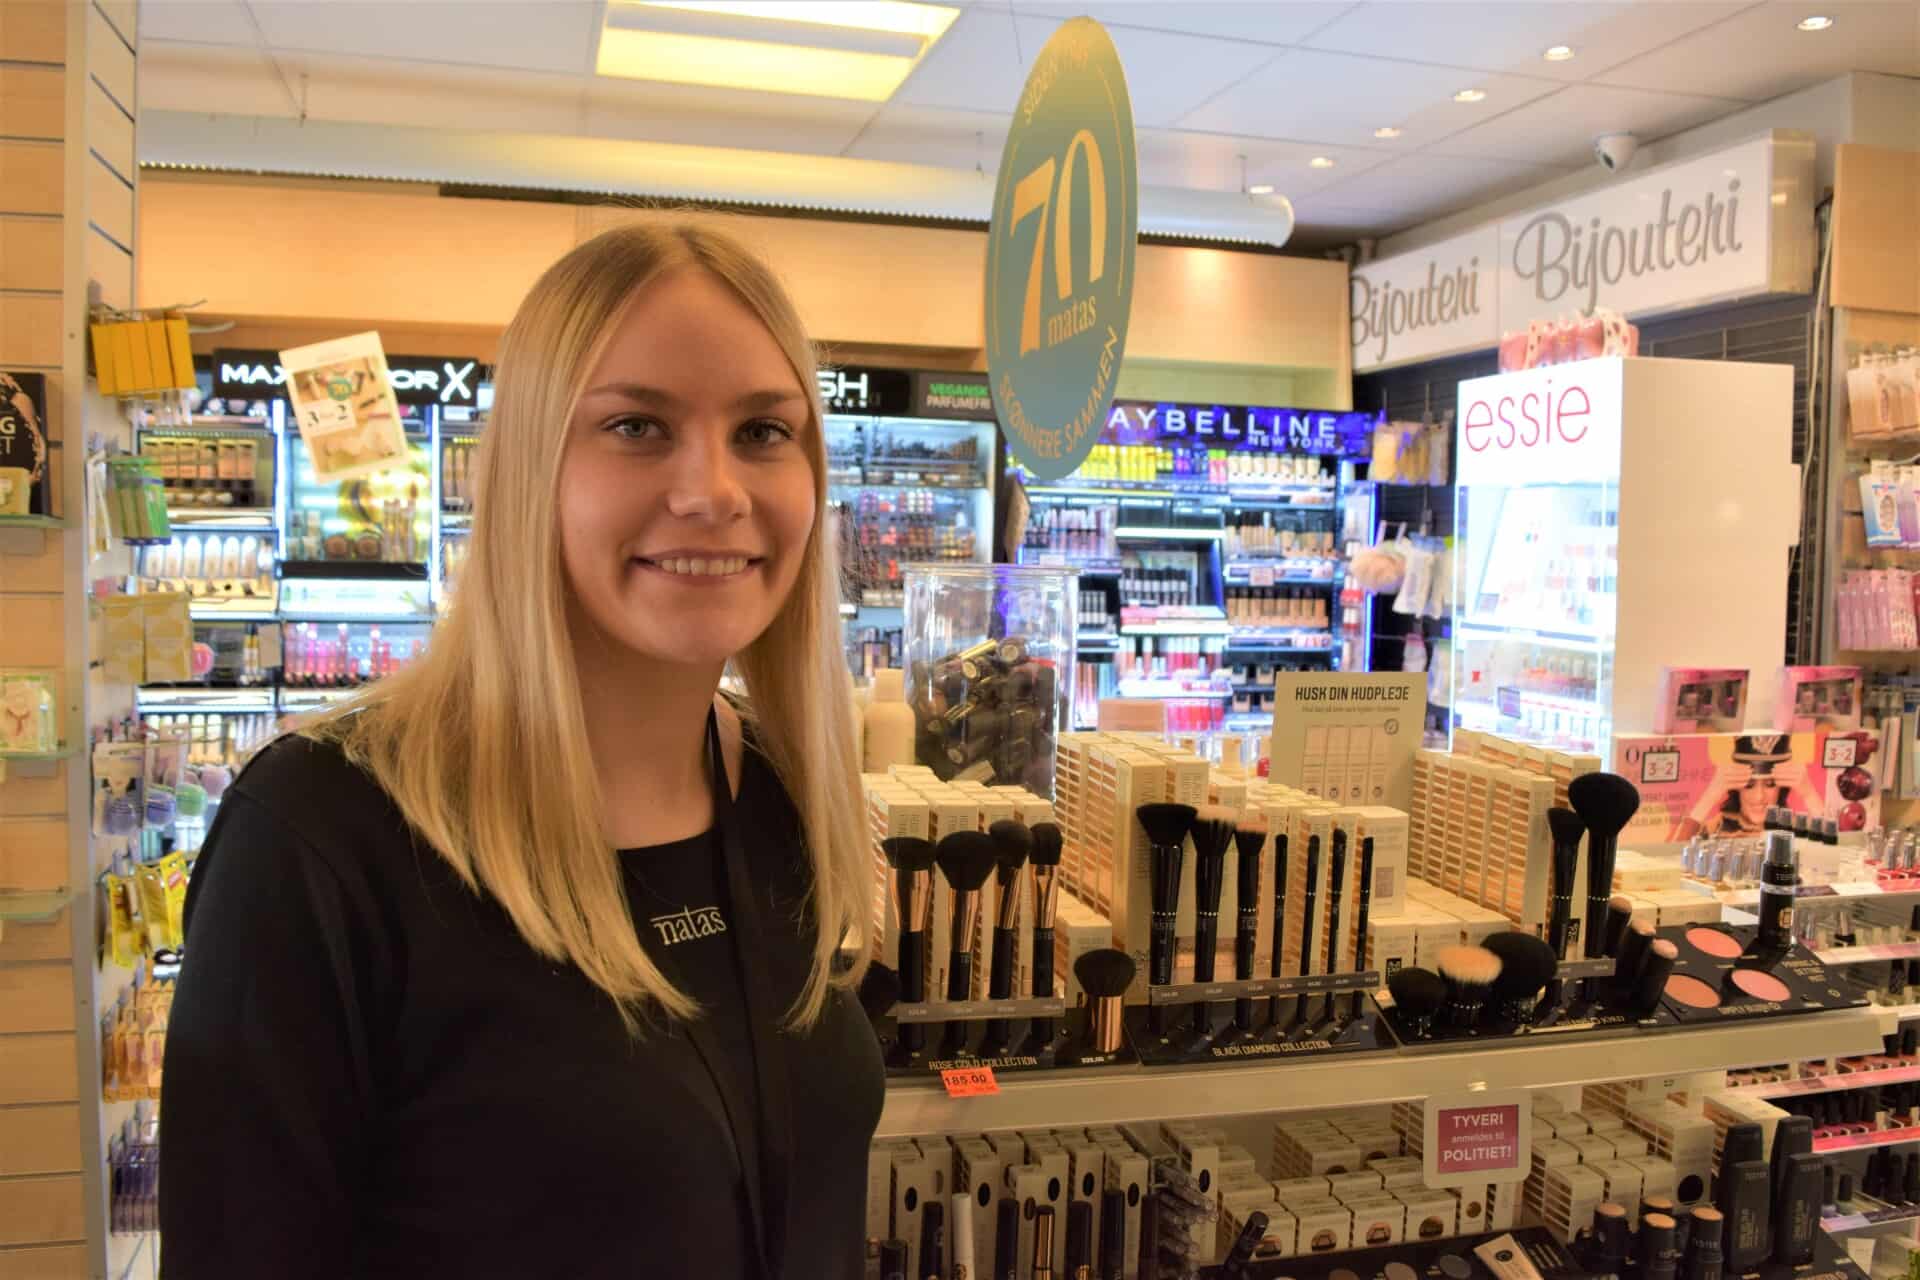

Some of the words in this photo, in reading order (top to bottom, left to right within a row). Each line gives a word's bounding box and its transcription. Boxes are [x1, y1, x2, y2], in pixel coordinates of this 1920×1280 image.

[1010, 129, 1107, 357] 70
[1513, 177, 1743, 316] Bijouteri
[1048, 296, 1096, 346] matas
[1352, 256, 1481, 360] Bijouteri
[816, 371, 868, 399] SH
[1107, 407, 1337, 440] AYBELLINE
[1464, 379, 1591, 453] essie
[1248, 435, 1285, 448] NEW
[1288, 437, 1335, 450] YORK
[1295, 686, 1328, 701] HUSK
[1329, 686, 1349, 701] DIN
[981, 1056, 1037, 1069] COLLECTION
[1452, 1112, 1504, 1129] TYVERI
[1442, 1145, 1512, 1163] POLITIET!
